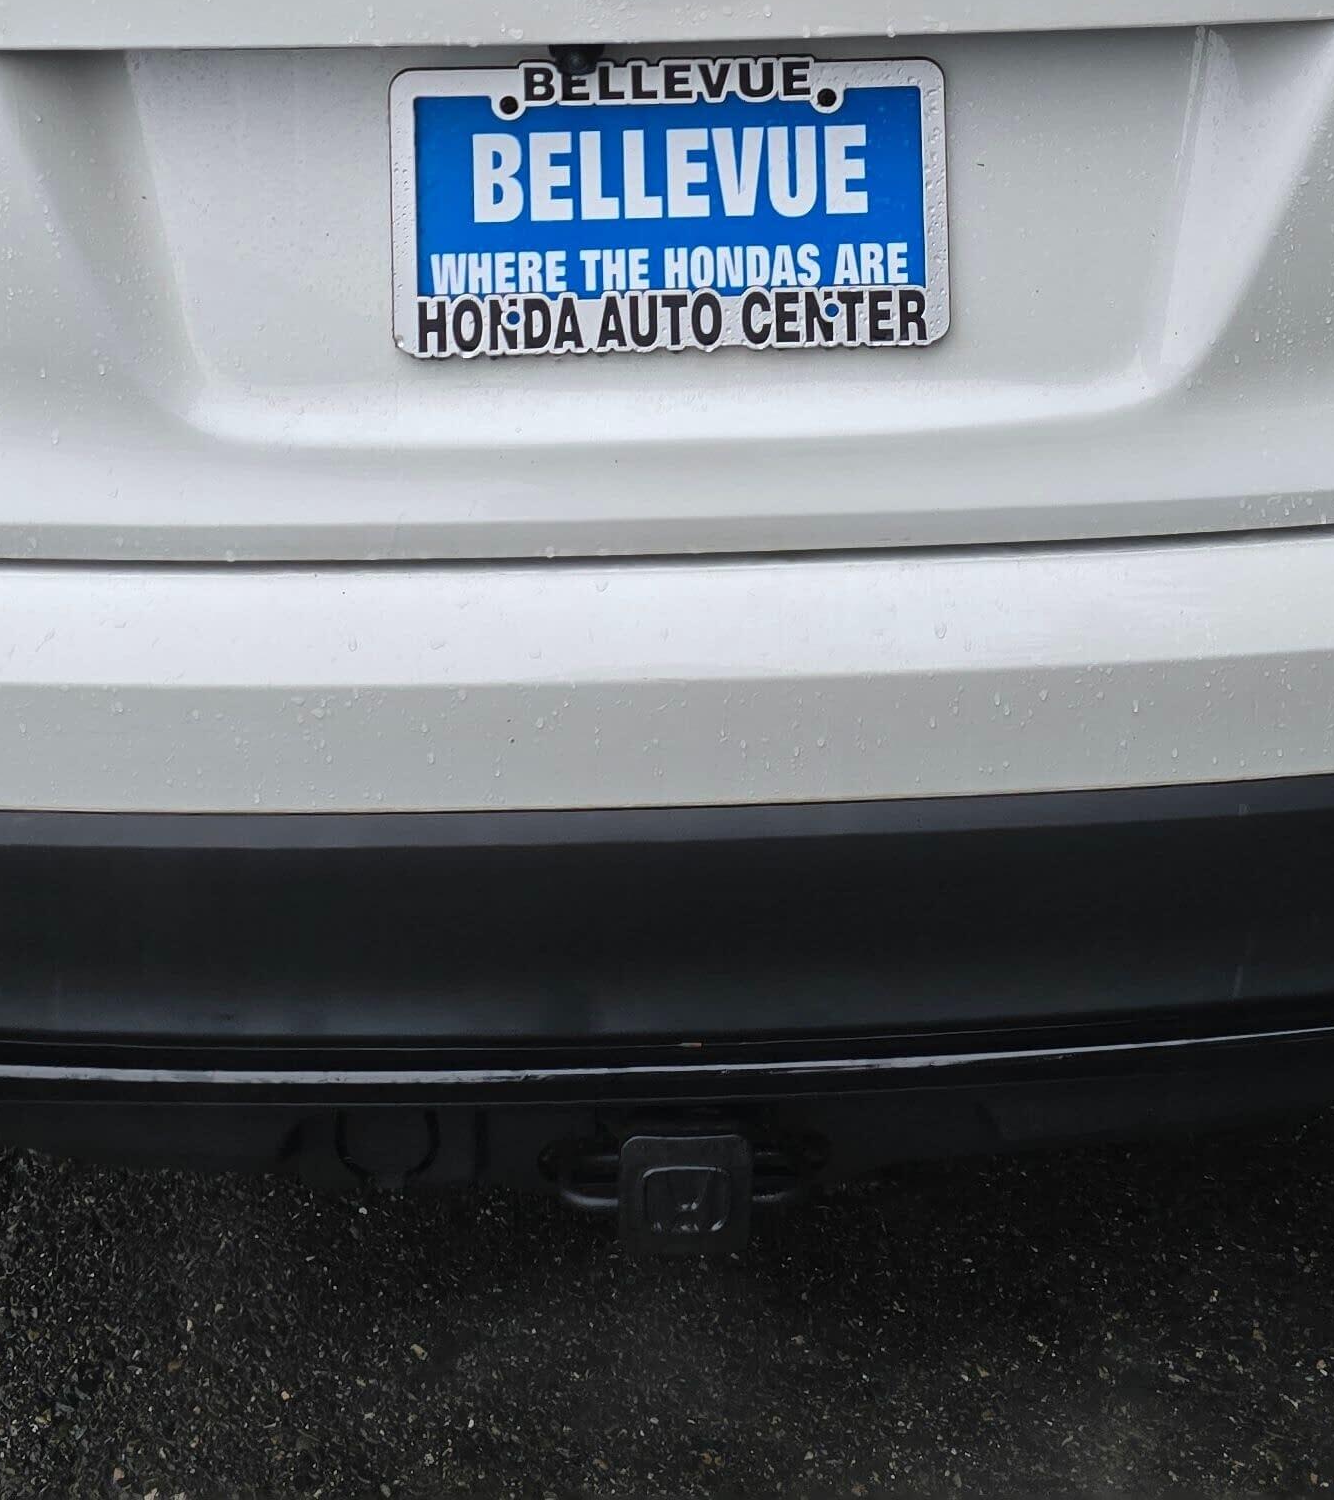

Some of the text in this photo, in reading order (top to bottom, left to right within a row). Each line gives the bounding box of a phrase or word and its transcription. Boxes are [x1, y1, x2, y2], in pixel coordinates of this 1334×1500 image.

[523, 60, 812, 102] BELLEVUE
[472, 124, 869, 223] BELLEVUE
[430, 241, 909, 296] WHERE THE HONDAS ARE
[417, 288, 928, 354] HONDA AUTO CENTER
